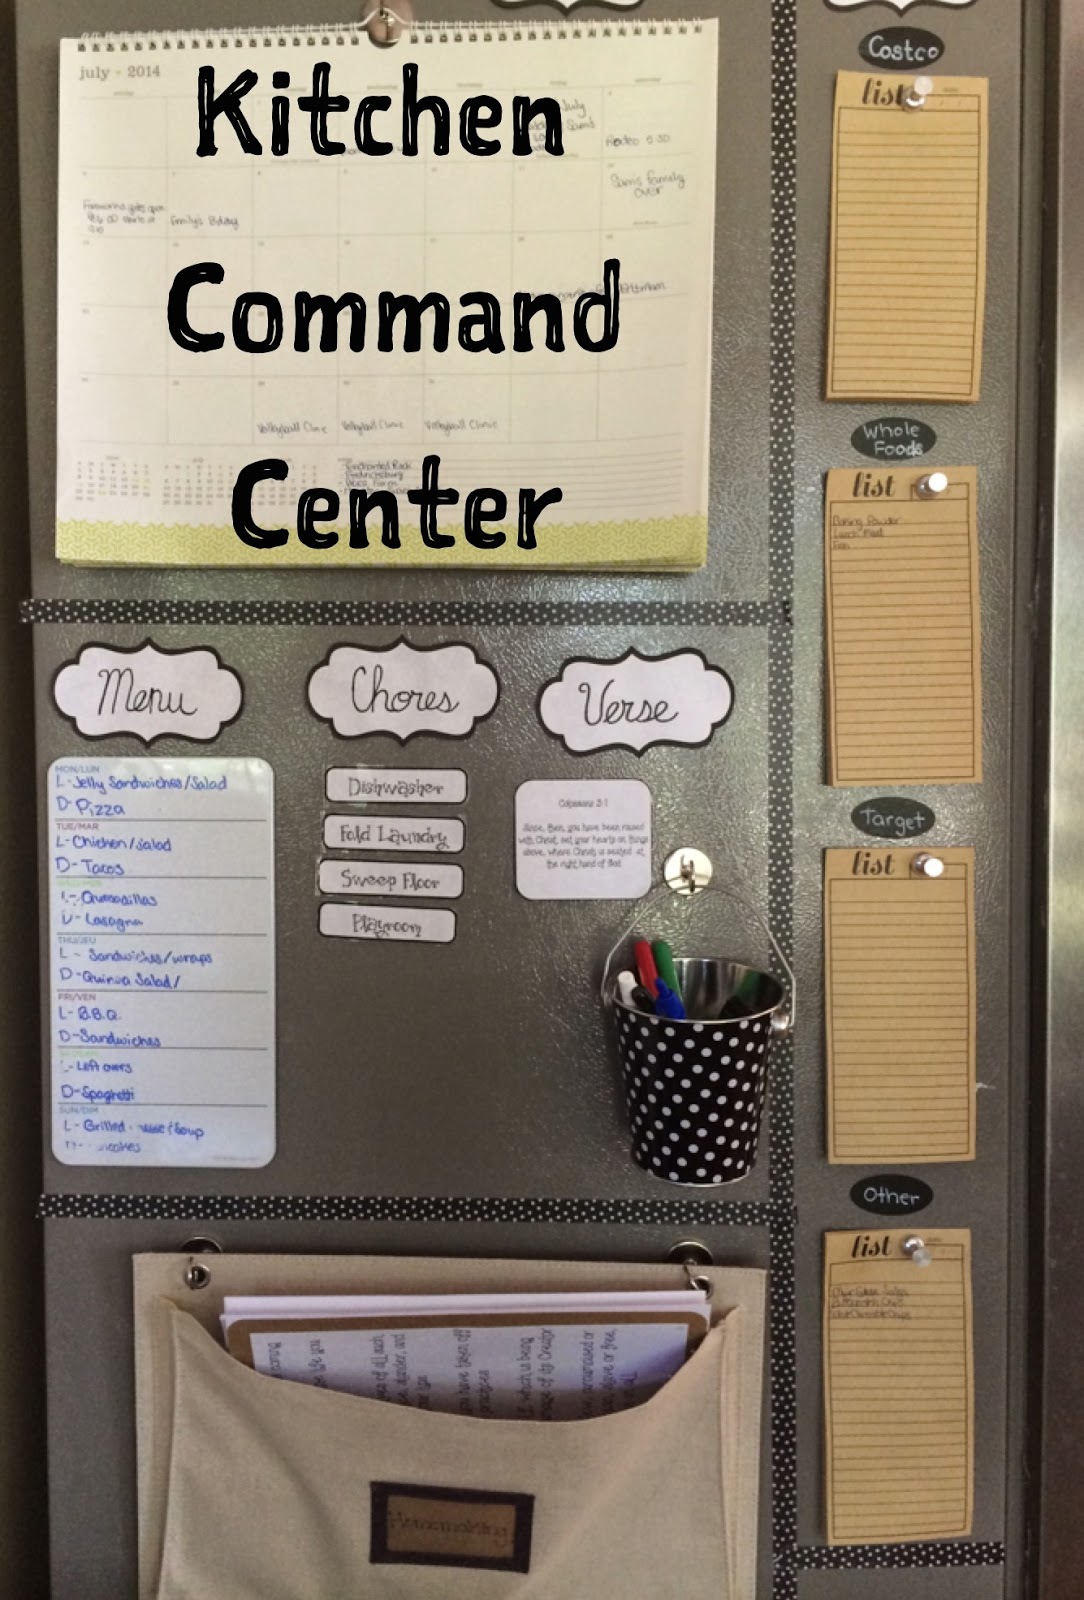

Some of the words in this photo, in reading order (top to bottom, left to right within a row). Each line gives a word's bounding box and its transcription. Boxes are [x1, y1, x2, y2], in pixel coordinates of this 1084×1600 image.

[868, 35, 939, 61] Costco
[79, 66, 110, 80] july
[127, 65, 161, 78] 2014
[863, 422, 920, 440] Whole
[873, 440, 924, 457] Foods
[853, 472, 896, 498] list
[98, 667, 198, 716] Menu
[351, 664, 460, 714] Chores
[578, 678, 679, 726] Verse
[348, 777, 445, 797] Dishwasher
[76, 798, 126, 817] Pizza
[56, 822, 100, 831] TUE/MAR
[859, 807, 926, 837] Target
[340, 824, 372, 843] Fold
[378, 827, 450, 851] Laundry
[81, 858, 125, 876] Tacos
[852, 850, 896, 876] list
[341, 868, 398, 892] Sweep
[402, 871, 441, 891] Floor
[352, 912, 422, 938] Playroom
[58, 993, 97, 1002] FRI/VEN
[863, 1186, 920, 1206] Other
[852, 1235, 892, 1259] list
